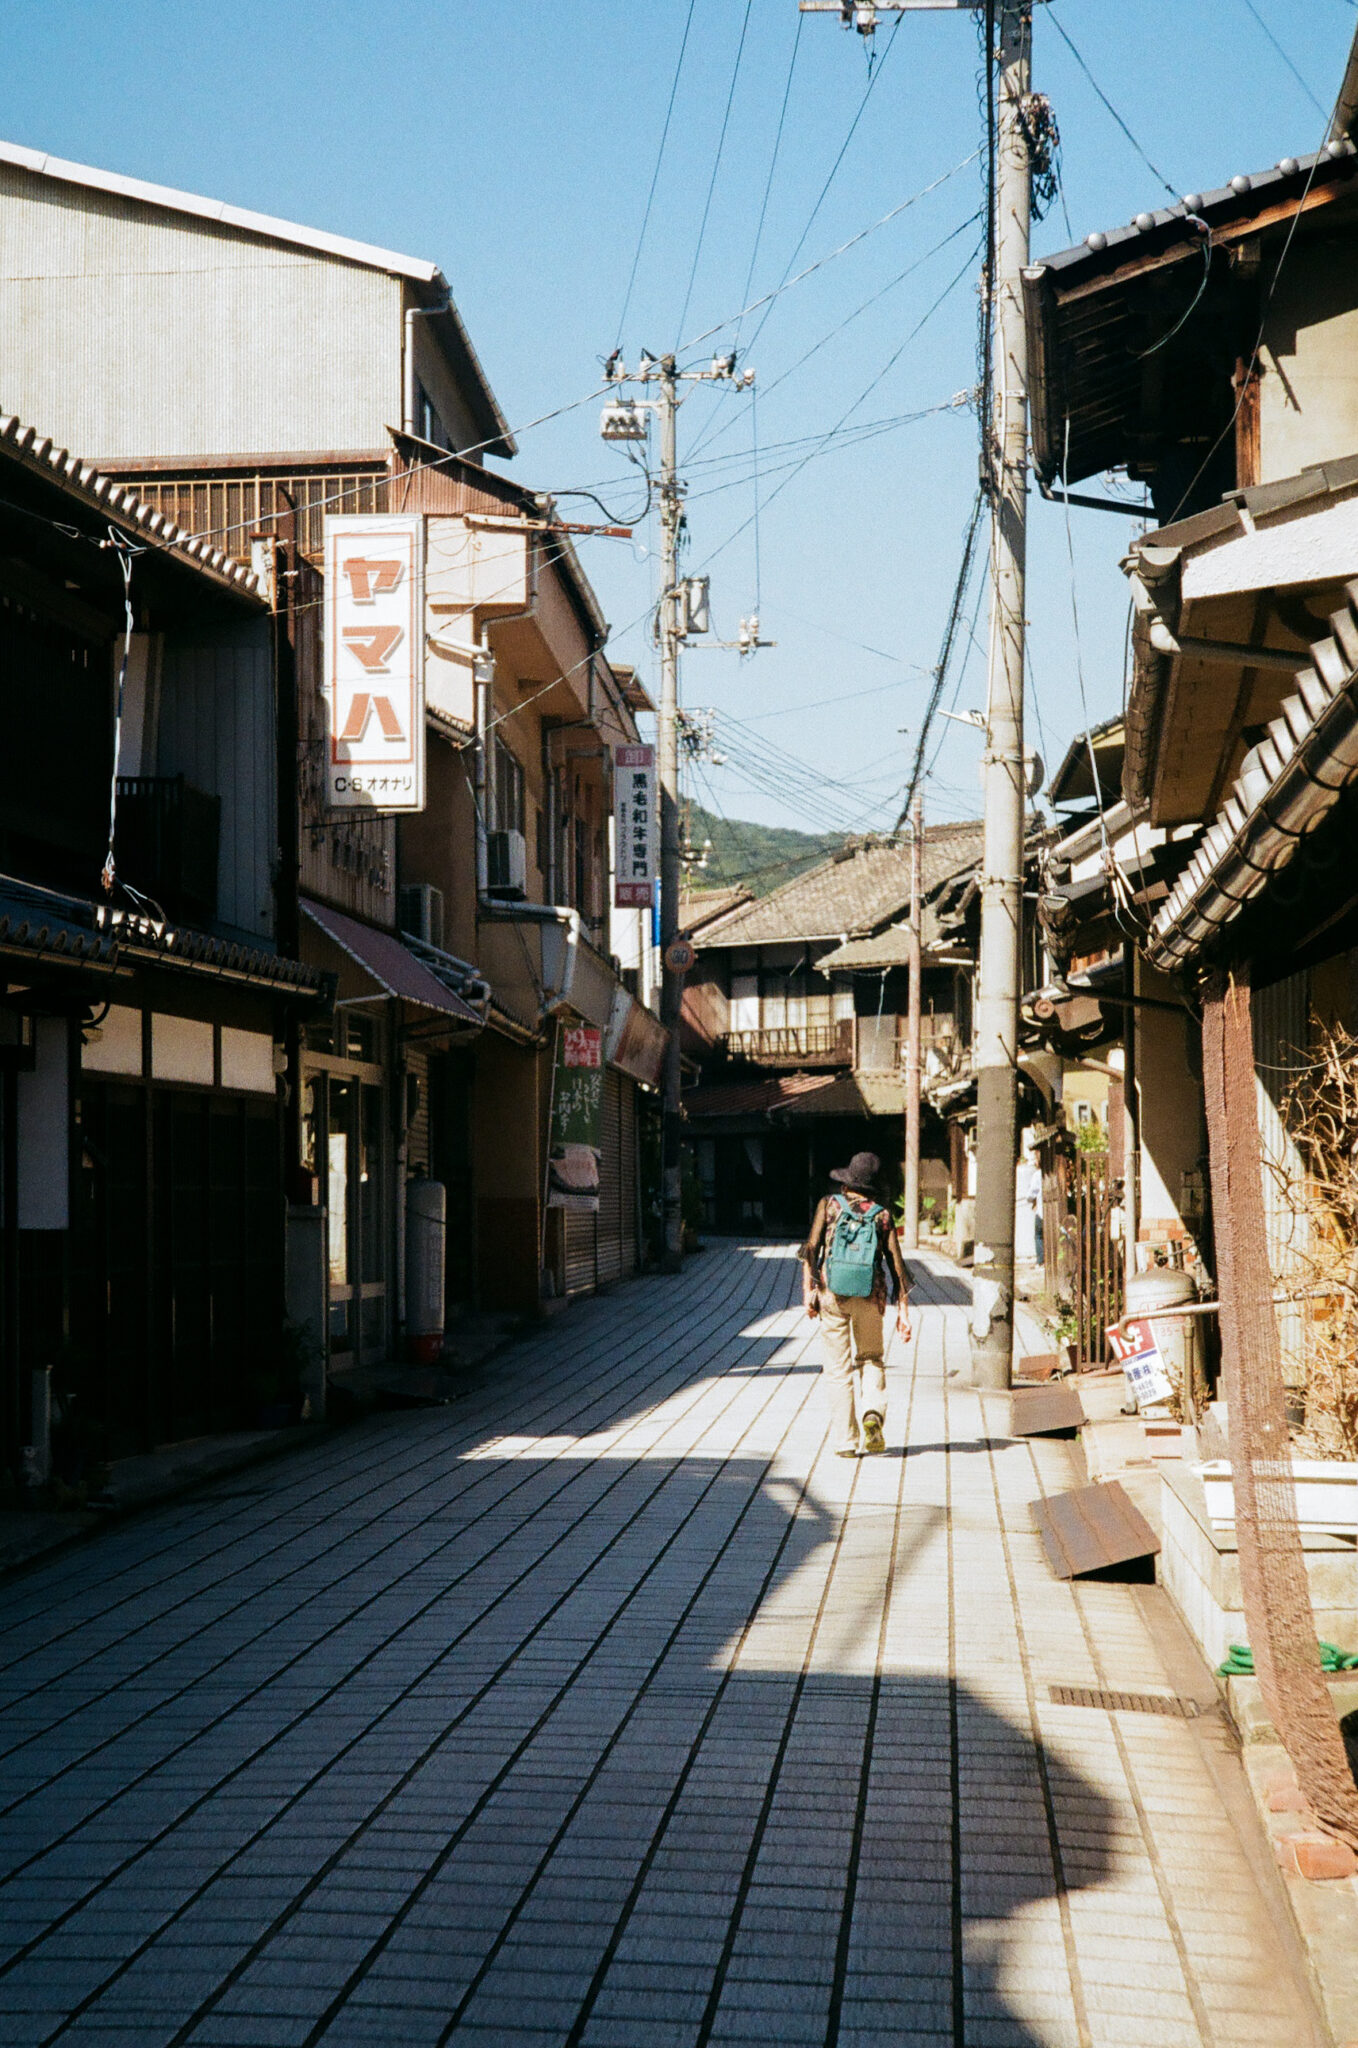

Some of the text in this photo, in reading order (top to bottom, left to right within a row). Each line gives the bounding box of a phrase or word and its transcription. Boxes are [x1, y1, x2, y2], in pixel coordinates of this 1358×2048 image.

[339, 557, 406, 742] ヤマハ
[367, 775, 413, 792] オオナリ
[632, 773, 648, 878] 黒毛和牛専門
[618, 886, 650, 902] 販売
